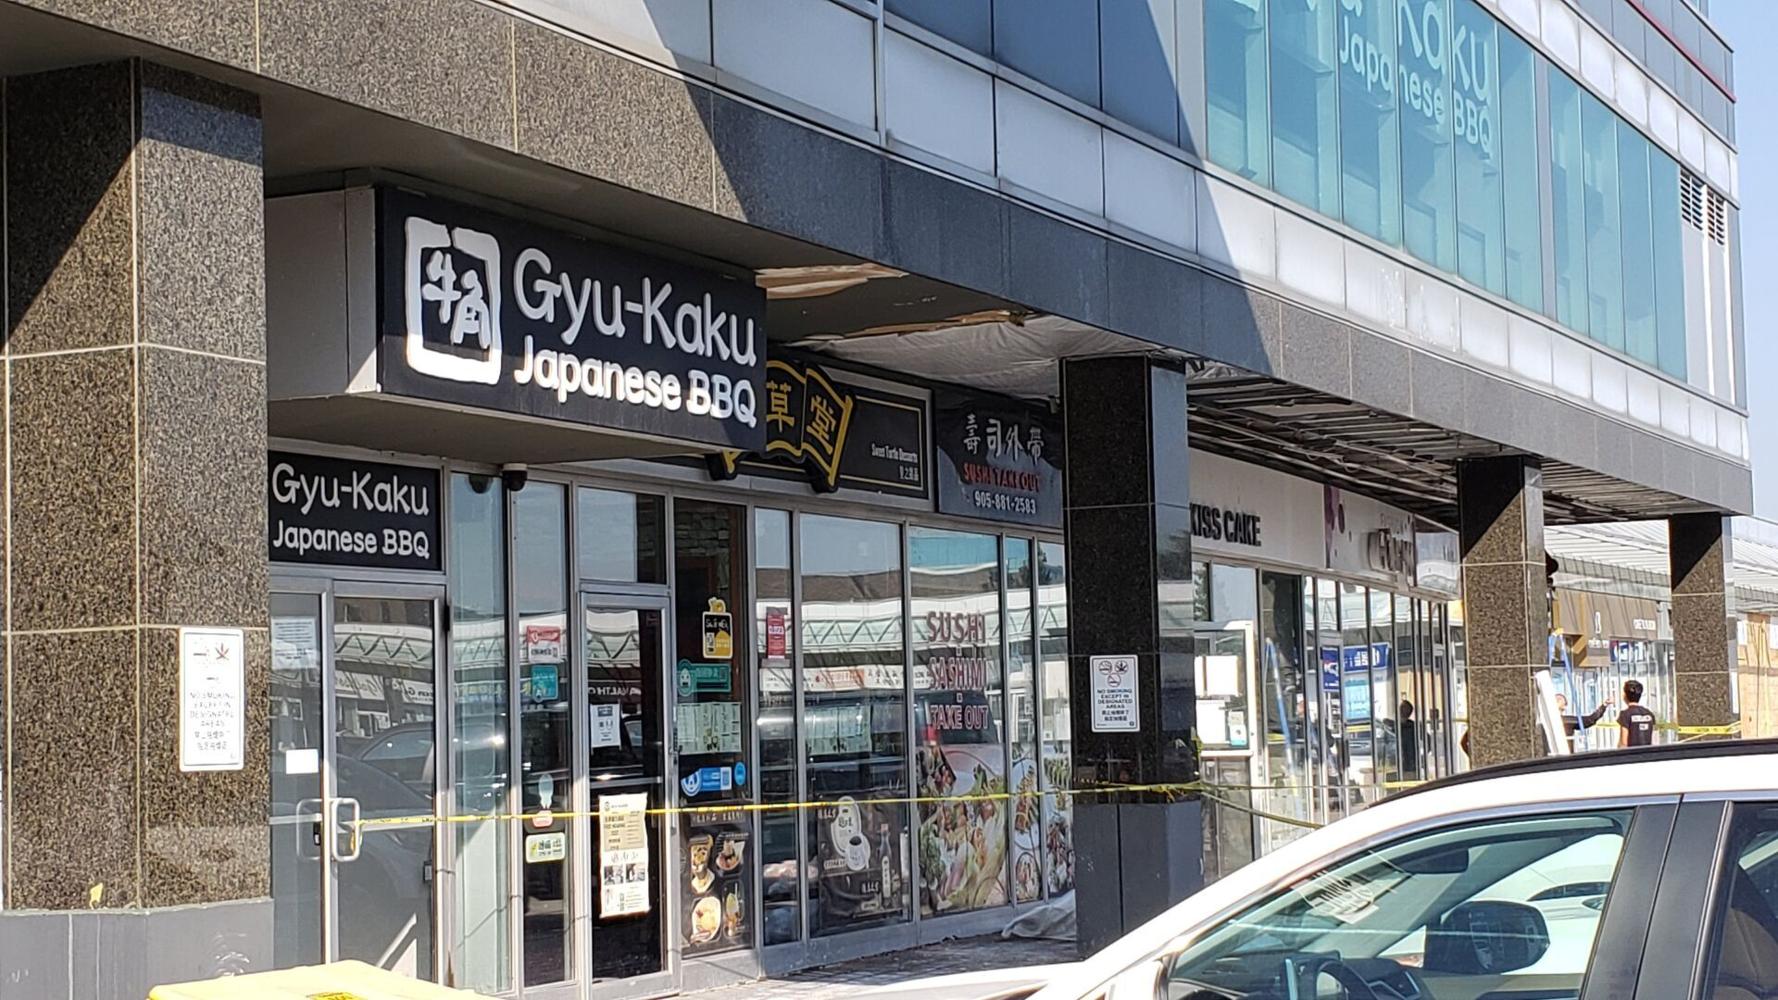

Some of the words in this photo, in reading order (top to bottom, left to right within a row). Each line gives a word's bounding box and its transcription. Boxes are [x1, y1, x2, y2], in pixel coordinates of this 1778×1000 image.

[1340, 15, 1445, 125] Japanese
[1453, 90, 1492, 155] BBQ
[513, 248, 757, 367] Gyu-Kaku
[514, 335, 683, 410] Japanese
[686, 369, 757, 428] BBQ
[272, 463, 429, 516] Gyu-Kaku
[963, 462, 993, 485] SUSHI
[1019, 471, 1041, 493] OUT
[974, 490, 1037, 514] 905-881-2583
[273, 520, 377, 556] Japanese
[382, 529, 430, 560] BBQ
[1224, 510, 1262, 547] CAKE
[927, 611, 986, 643] SUSHI
[928, 657, 987, 690] SASHIMI
[930, 705, 962, 730] TAKE
[964, 705, 988, 730] OUT
